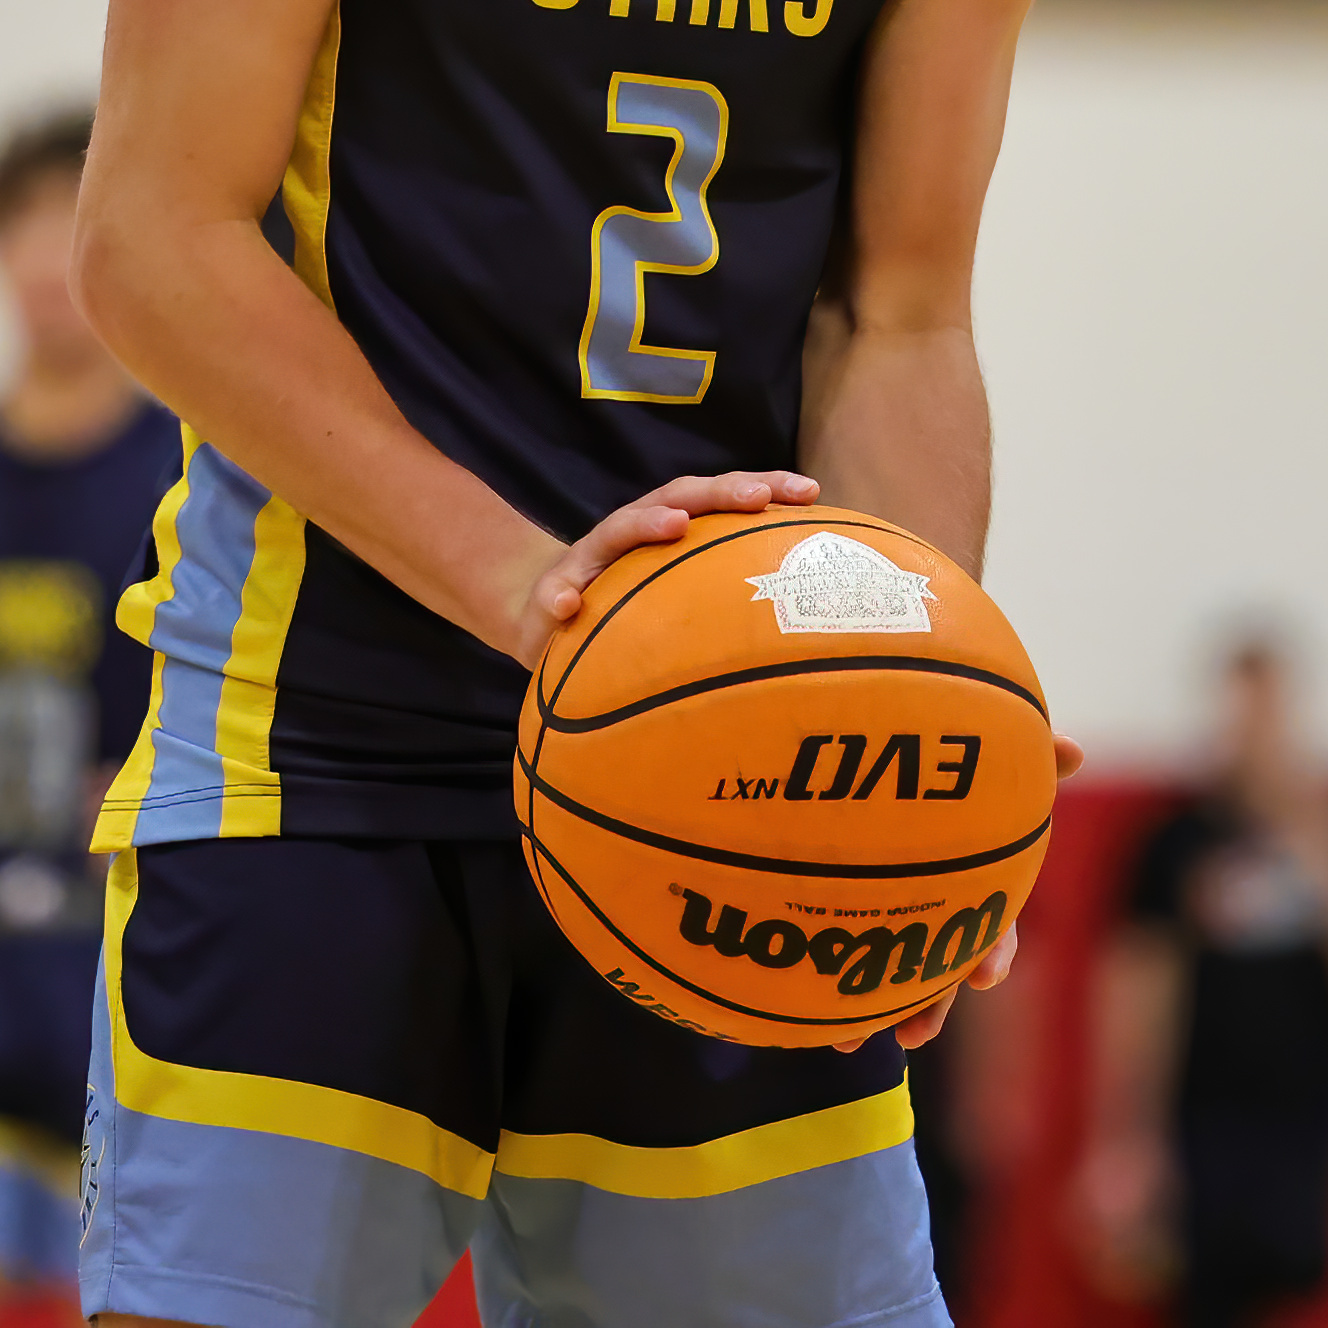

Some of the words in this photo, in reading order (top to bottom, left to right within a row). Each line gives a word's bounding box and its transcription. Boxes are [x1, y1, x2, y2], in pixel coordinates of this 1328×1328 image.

[578, 71, 729, 404] 2
[783, 733, 981, 801] EVO
[707, 777, 780, 801] NXT
[784, 901, 827, 915] BALL
[834, 908, 880, 917] GAME
[887, 899, 946, 916] INDOOR
[679, 888, 1007, 995] Wilson
